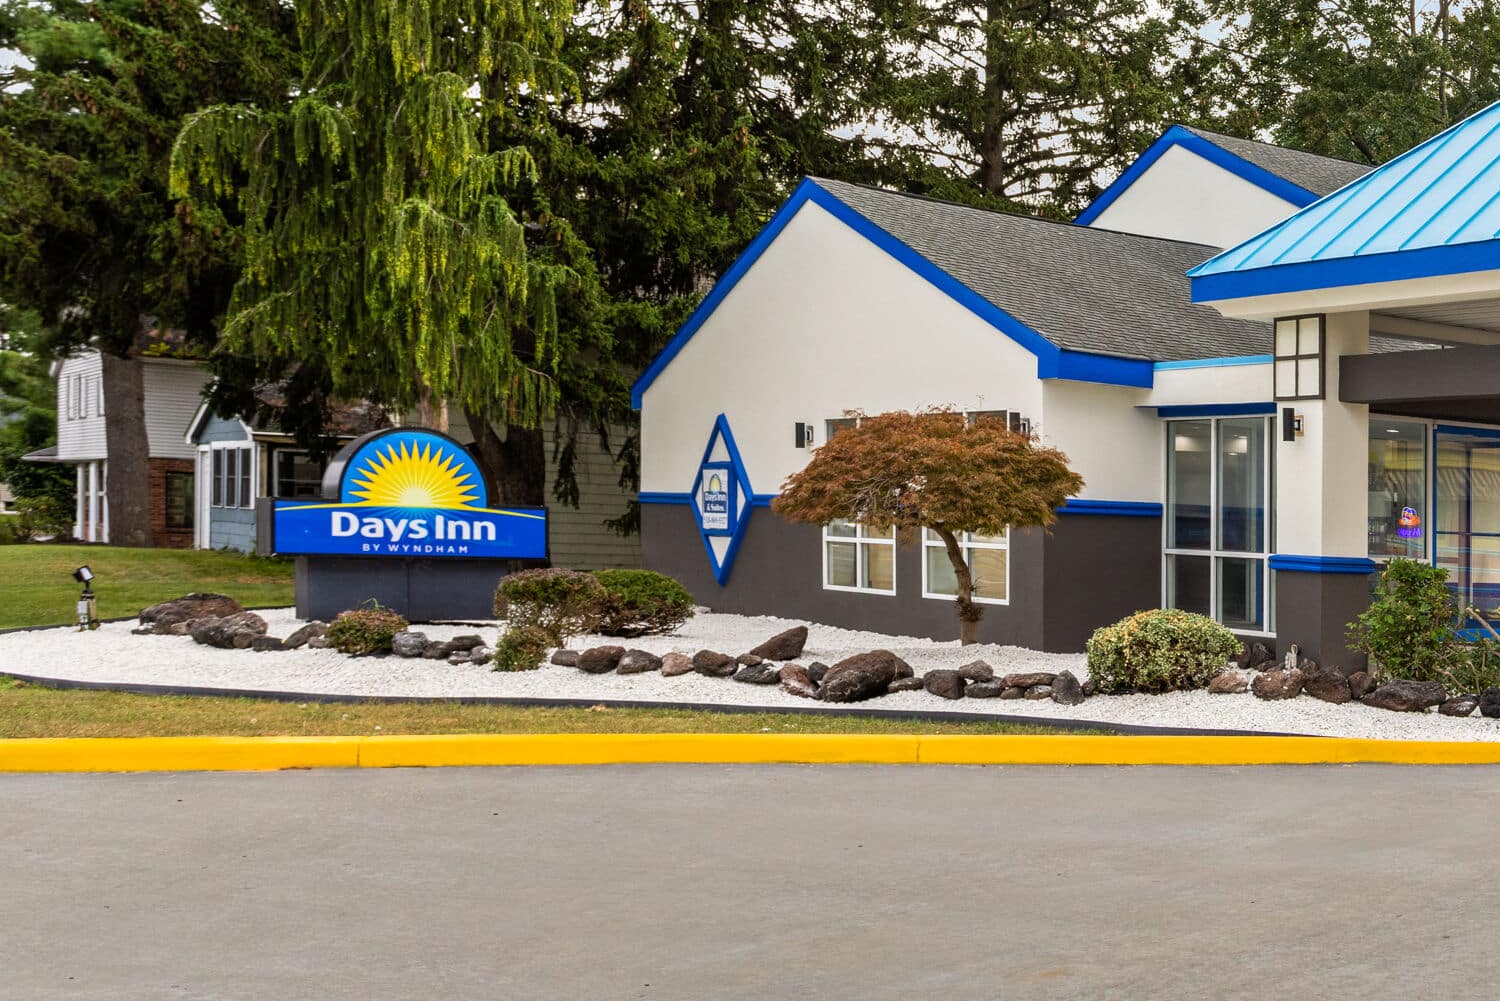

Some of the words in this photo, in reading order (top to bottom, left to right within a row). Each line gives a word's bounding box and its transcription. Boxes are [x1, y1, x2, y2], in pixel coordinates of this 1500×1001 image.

[331, 511, 428, 543] Days
[435, 515, 497, 541] Inn
[362, 543, 380, 552] BY
[388, 544, 469, 554] WYNDHAM
